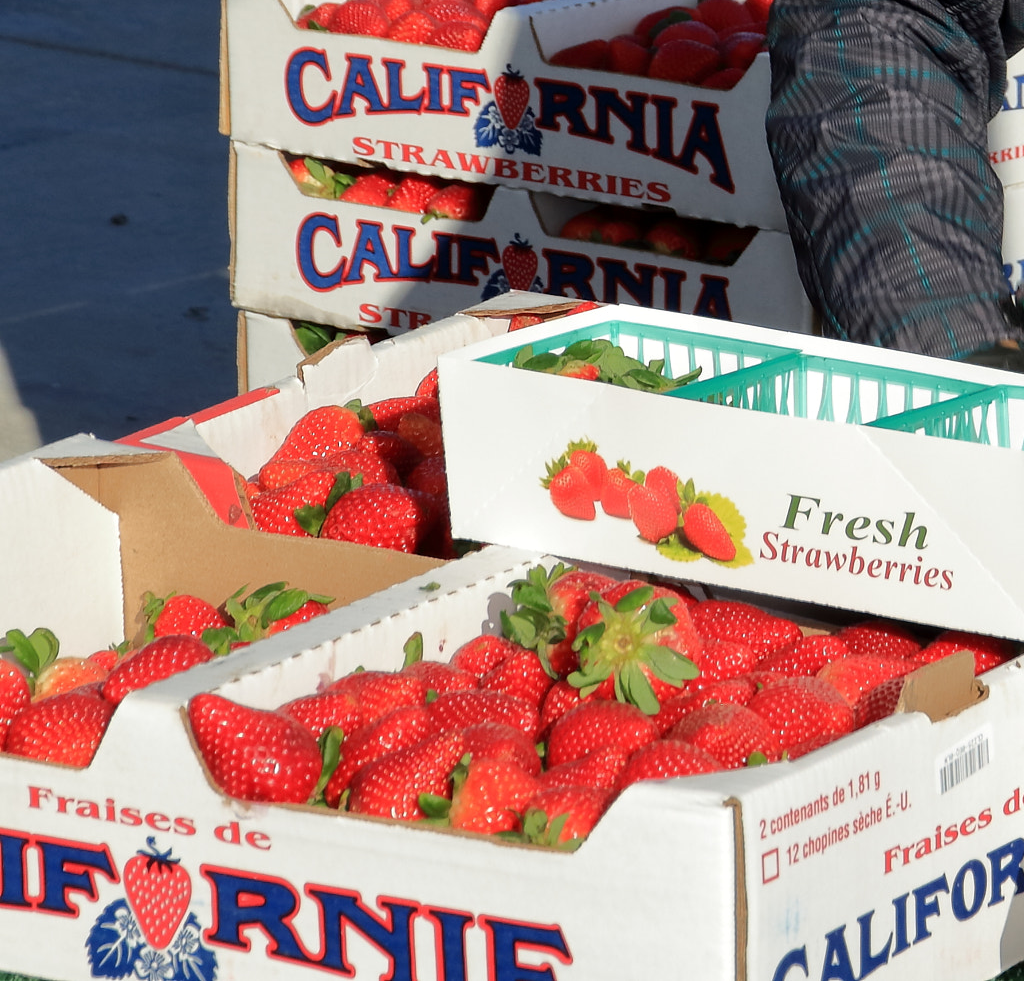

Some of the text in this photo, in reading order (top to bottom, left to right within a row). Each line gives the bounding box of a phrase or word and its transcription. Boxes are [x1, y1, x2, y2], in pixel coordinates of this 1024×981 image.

[285, 46, 735, 194] CALIFRNIA
[352, 136, 671, 203] STRAWBERRIES
[779, 493, 928, 550] Fresh
[760, 531, 954, 590] Strawberries
[27, 785, 273, 851] Fraises de
[759, 771, 881, 839] 2 contenants de 1,81 g
[786, 843, 799, 866] 12
[802, 821, 849, 858] chopines
[853, 808, 882, 835] sèche
[884, 806, 993, 875] Fraises
